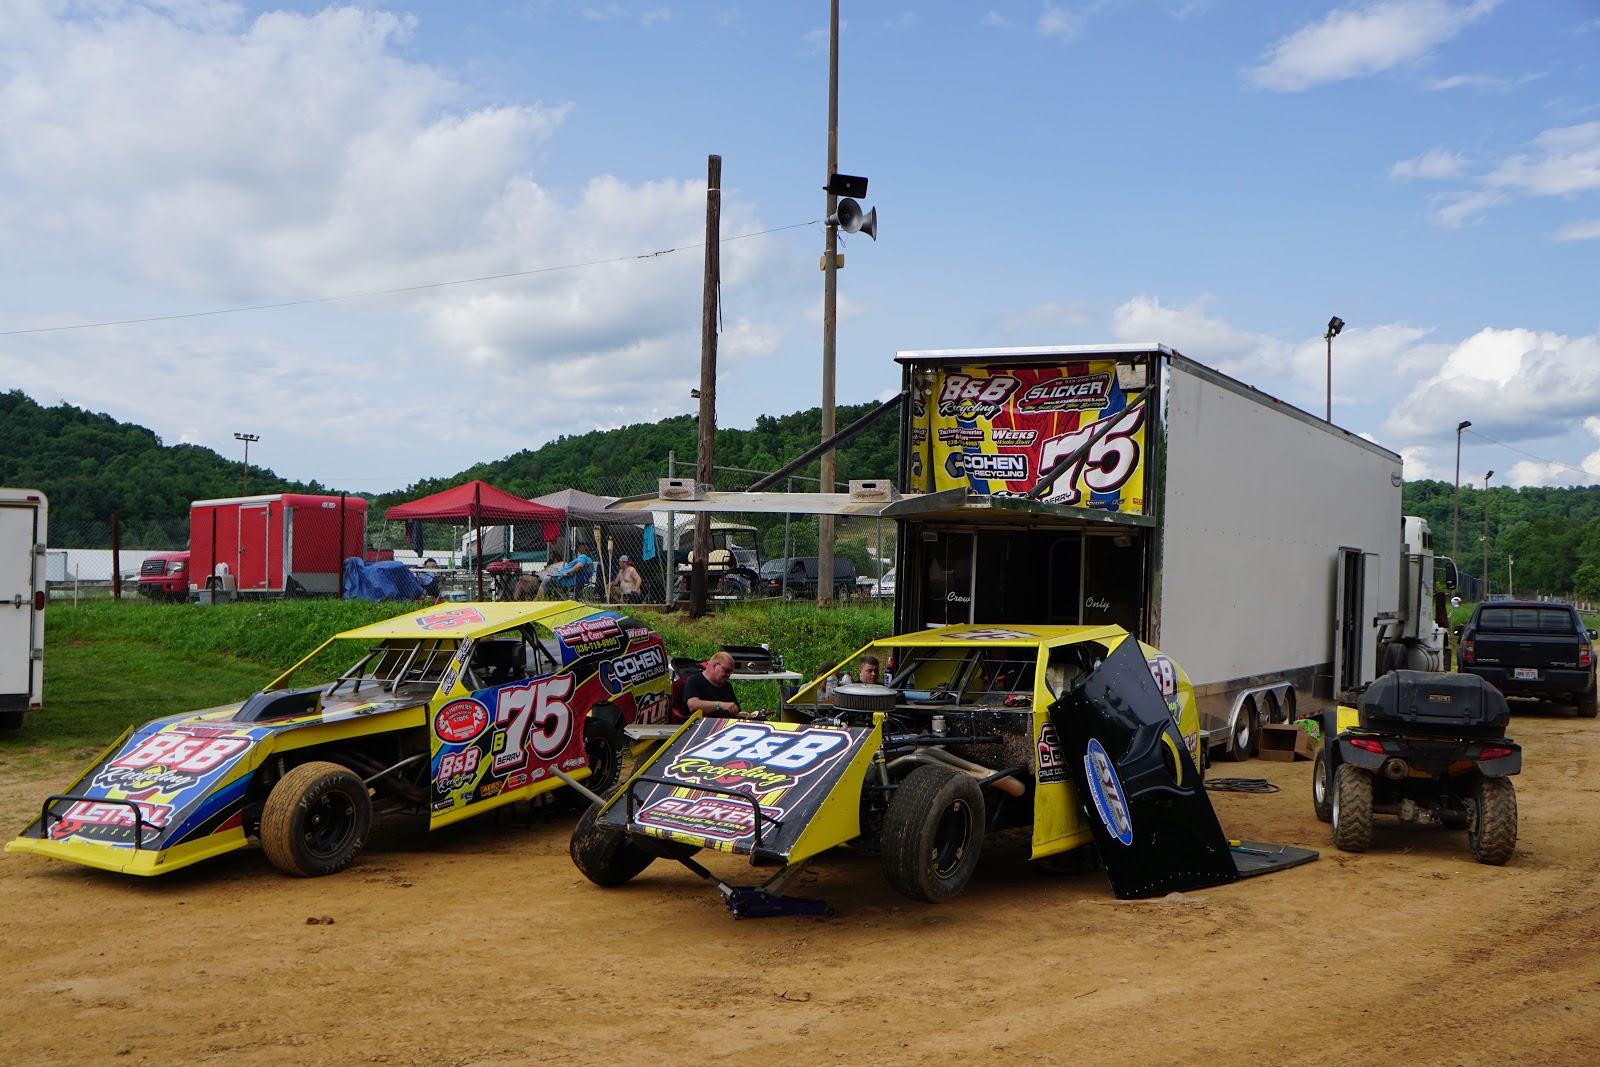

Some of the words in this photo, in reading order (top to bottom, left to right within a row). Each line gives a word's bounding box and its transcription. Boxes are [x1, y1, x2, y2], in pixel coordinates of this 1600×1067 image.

[942, 375, 1014, 401] B&B
[1028, 381, 1104, 399] SLICKER
[940, 400, 997, 417] Recycling
[963, 456, 1023, 470] COHEN
[1041, 405, 1141, 503] 75
[974, 470, 1024, 478] RECYCLING
[946, 591, 971, 602] Crew
[1085, 597, 1110, 612] Only
[556, 623, 583, 637] Tarheel
[582, 618, 616, 631] Converter
[581, 633, 588, 642] &
[613, 647, 663, 677] COHEN
[630, 665, 664, 683] RECYCLING
[496, 674, 573, 768] 75
[117, 733, 246, 771] B&B
[493, 732, 505, 753] B
[690, 727, 843, 769] B&B
[440, 750, 478, 780] B&B
[496, 751, 521, 765] BERRY
[98, 767, 197, 789] Recycling
[670, 758, 792, 787] Recycling
[1093, 751, 1129, 833] ESTES
[78, 825, 152, 841] CHASSS
